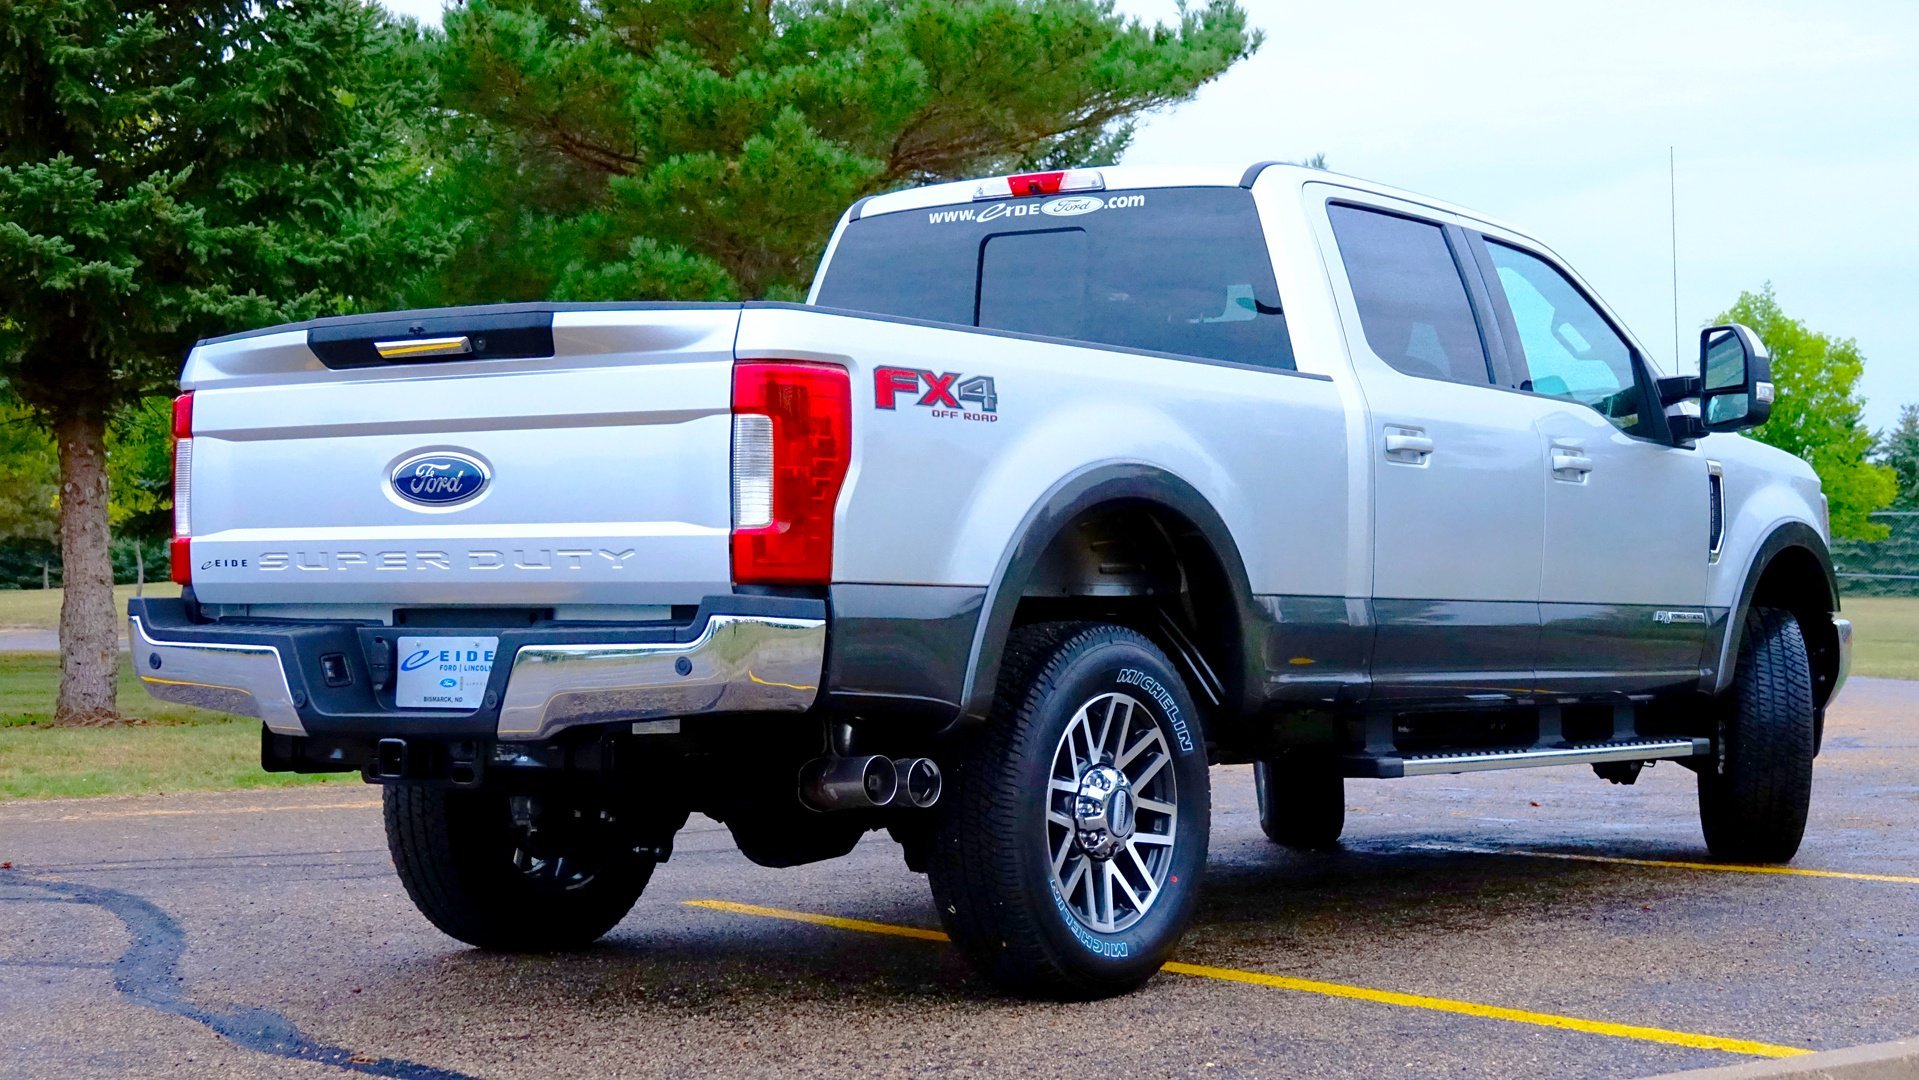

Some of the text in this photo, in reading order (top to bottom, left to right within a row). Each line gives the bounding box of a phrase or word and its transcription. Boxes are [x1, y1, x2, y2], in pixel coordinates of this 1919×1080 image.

[873, 365, 998, 413] FX4
[931, 409, 998, 423] OFF ROAD
[410, 463, 464, 494] Ford
[258, 548, 635, 571] SUPER DUTY
[439, 650, 494, 662] EIDE
[1116, 668, 1194, 752] MICHELIN
[1049, 879, 1129, 958] MICHELIN
